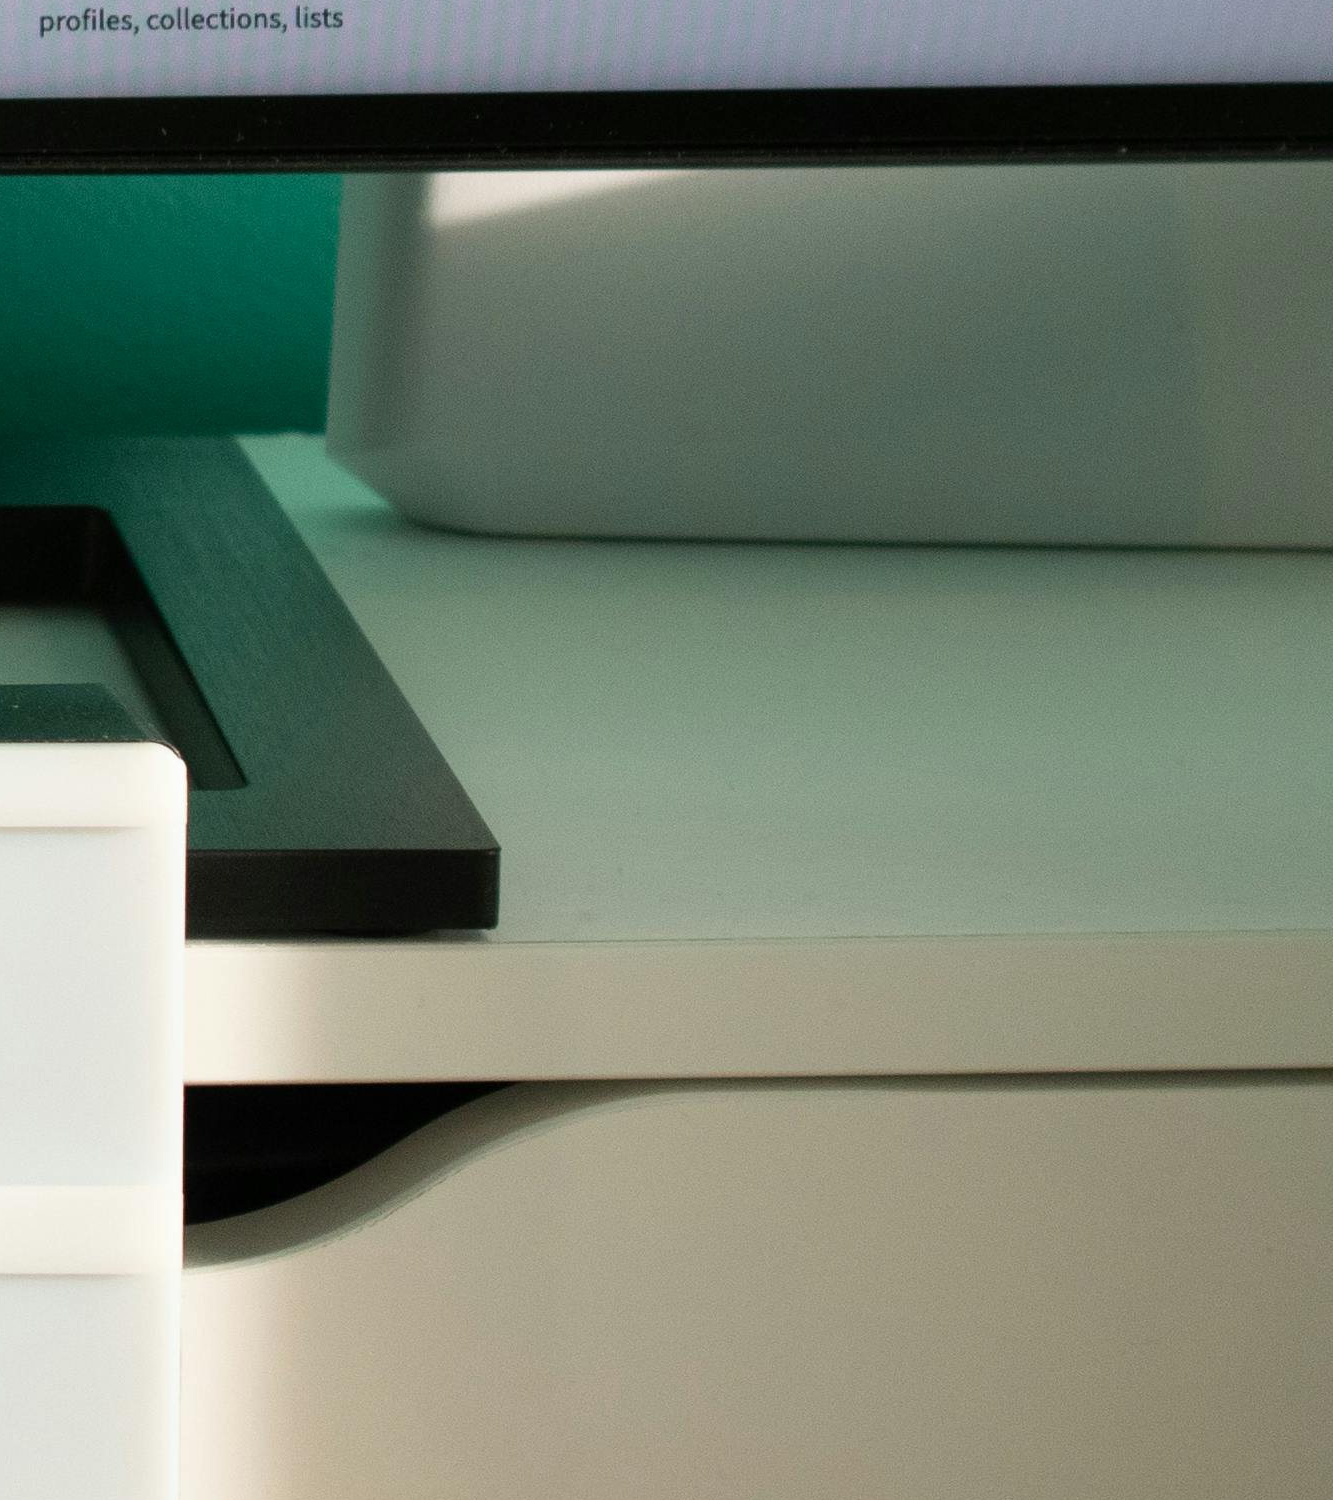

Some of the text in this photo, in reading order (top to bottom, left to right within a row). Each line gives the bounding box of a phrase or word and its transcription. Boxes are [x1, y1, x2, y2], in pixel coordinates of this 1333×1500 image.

[39, 4, 344, 37] profiles, collections, lists
